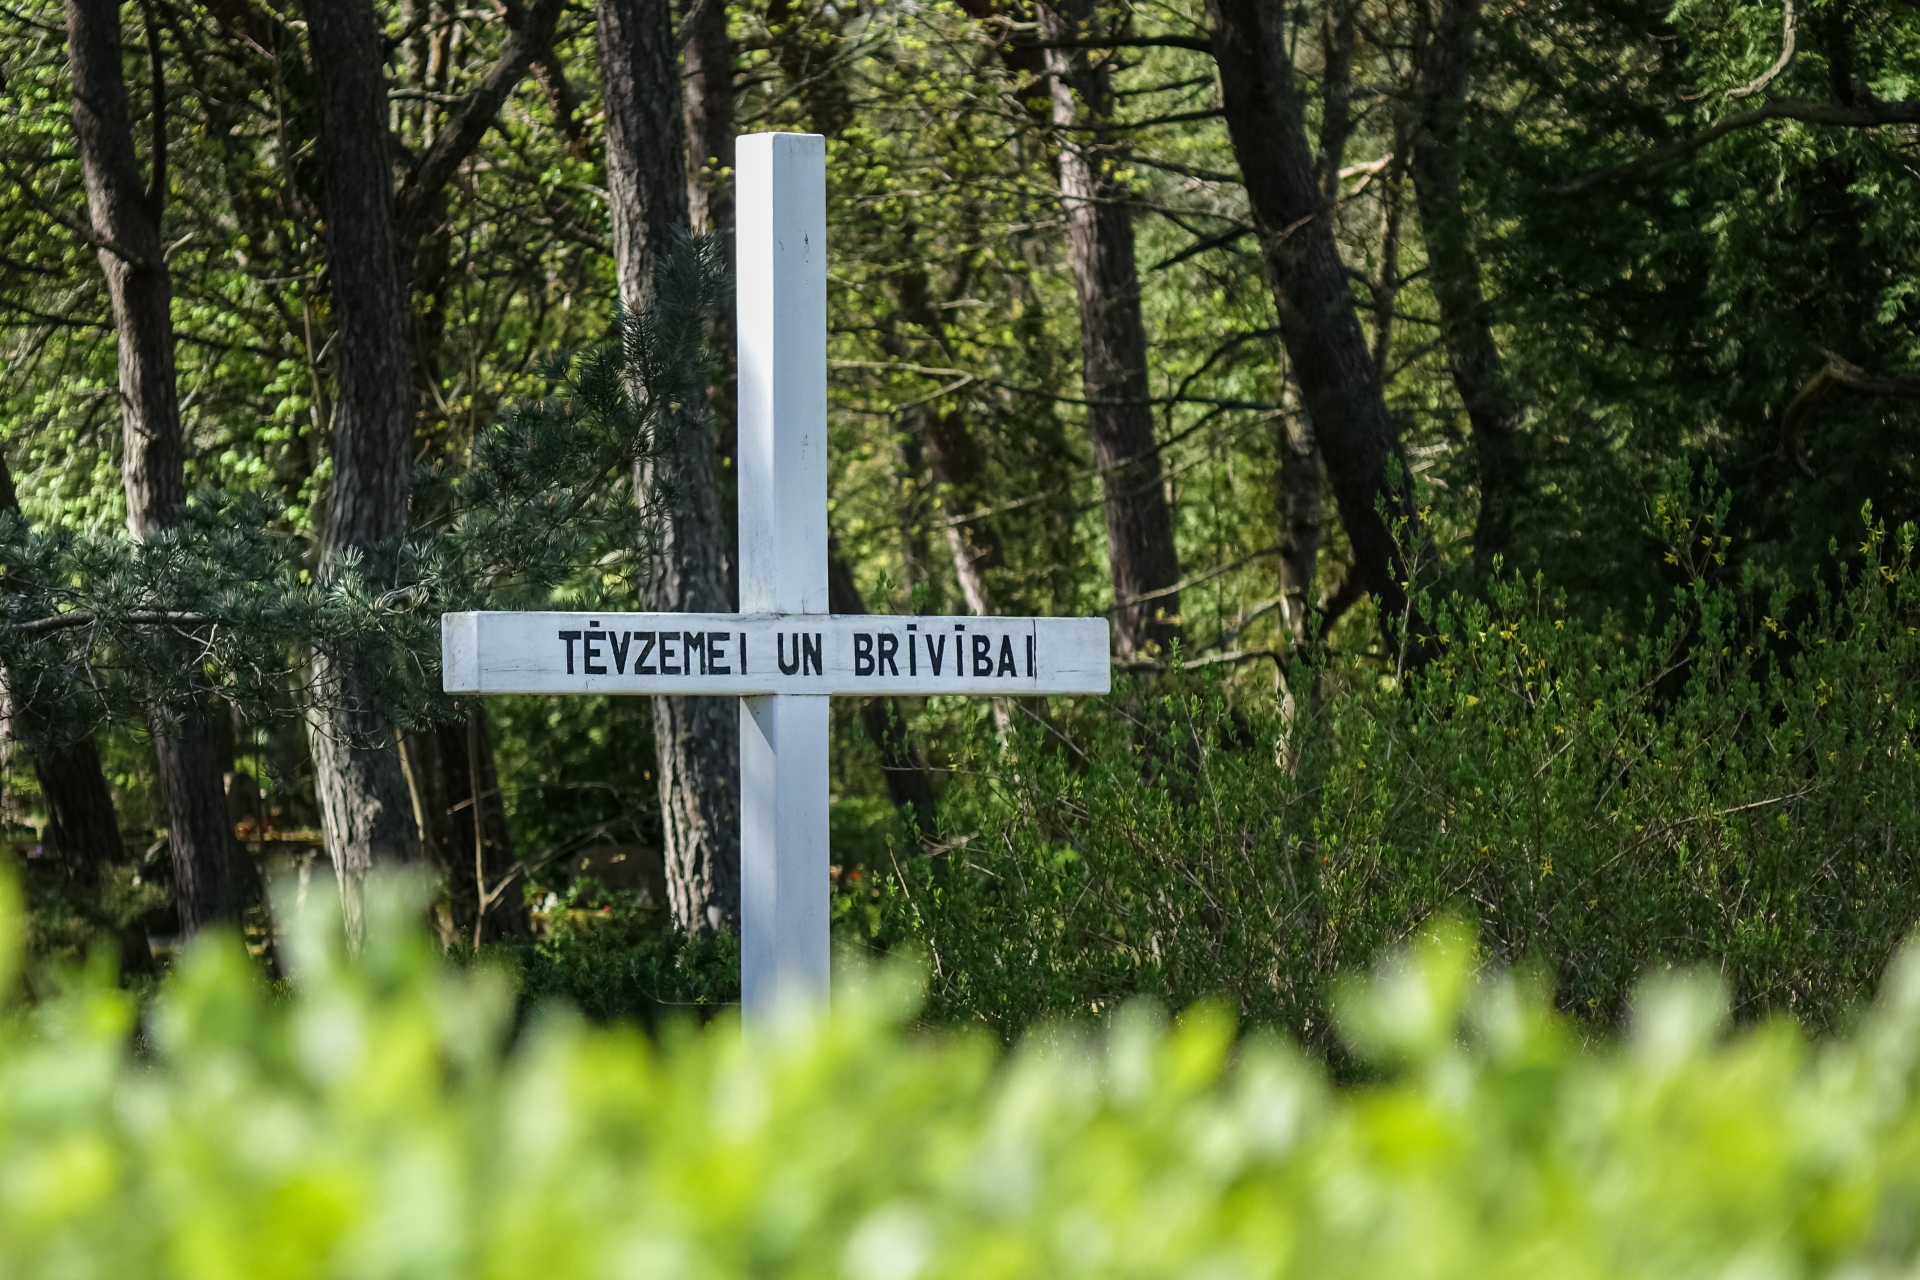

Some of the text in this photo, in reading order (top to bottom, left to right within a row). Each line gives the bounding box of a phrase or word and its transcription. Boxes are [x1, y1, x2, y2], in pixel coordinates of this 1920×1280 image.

[558, 620, 1034, 678] TĒVZEMEI UN BRĪVĪBAI
